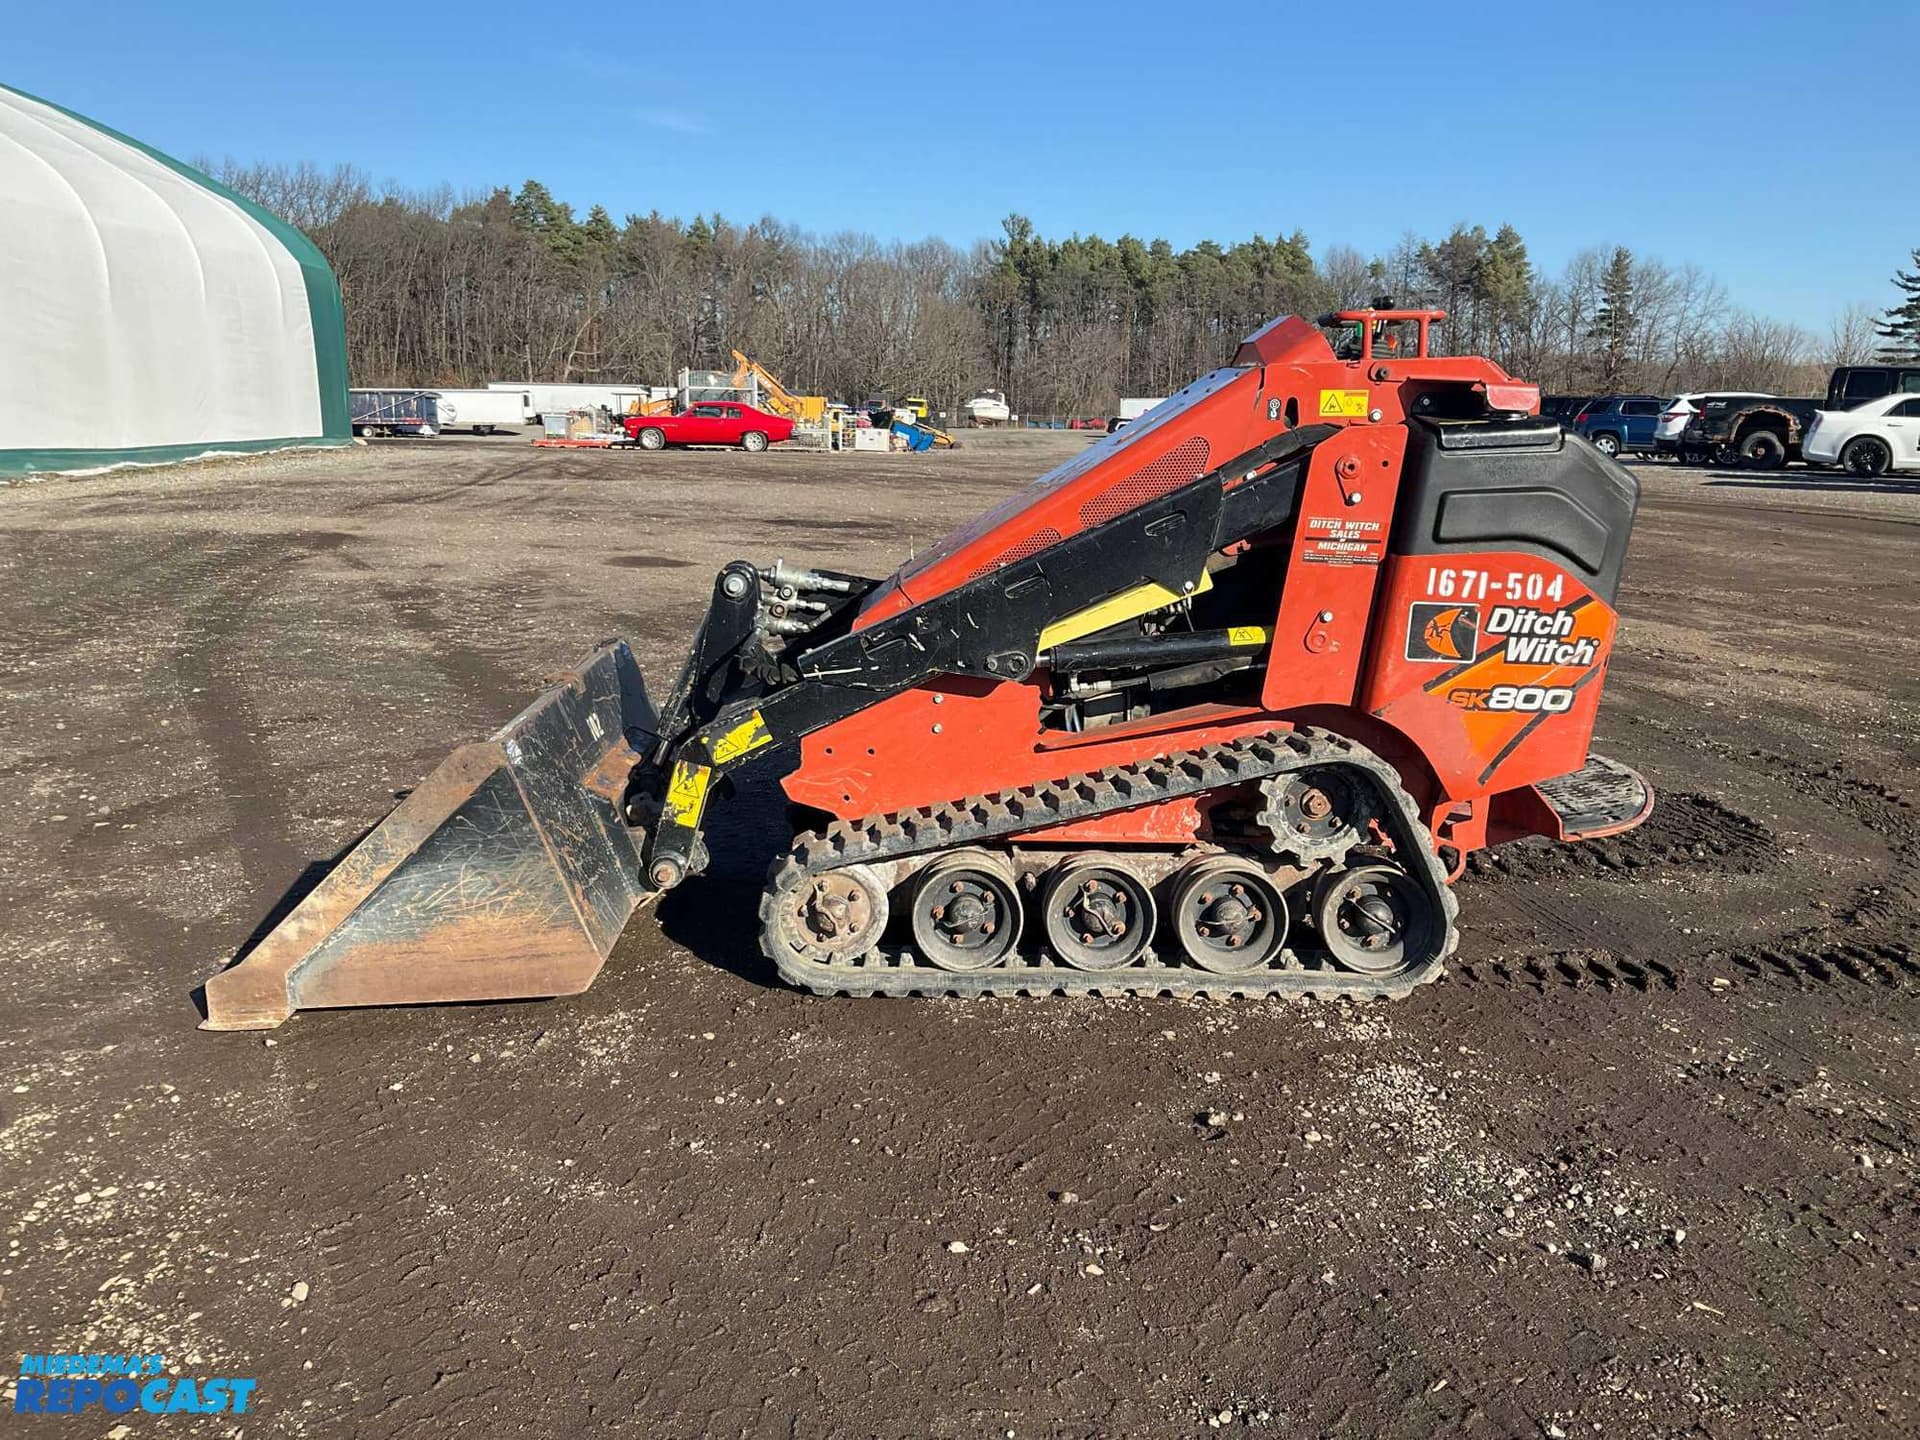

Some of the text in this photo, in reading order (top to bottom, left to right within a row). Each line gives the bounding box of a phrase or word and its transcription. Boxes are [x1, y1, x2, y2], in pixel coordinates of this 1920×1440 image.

[1309, 520, 1380, 531] DITCH WITCH
[1329, 529, 1361, 539] SALES
[1317, 542, 1368, 552] MICHIGAN
[1427, 567, 1563, 602] 1671-504
[1486, 607, 1573, 636] Ditch
[1506, 636, 1594, 665] Witch
[1450, 686, 1574, 712] SK800
